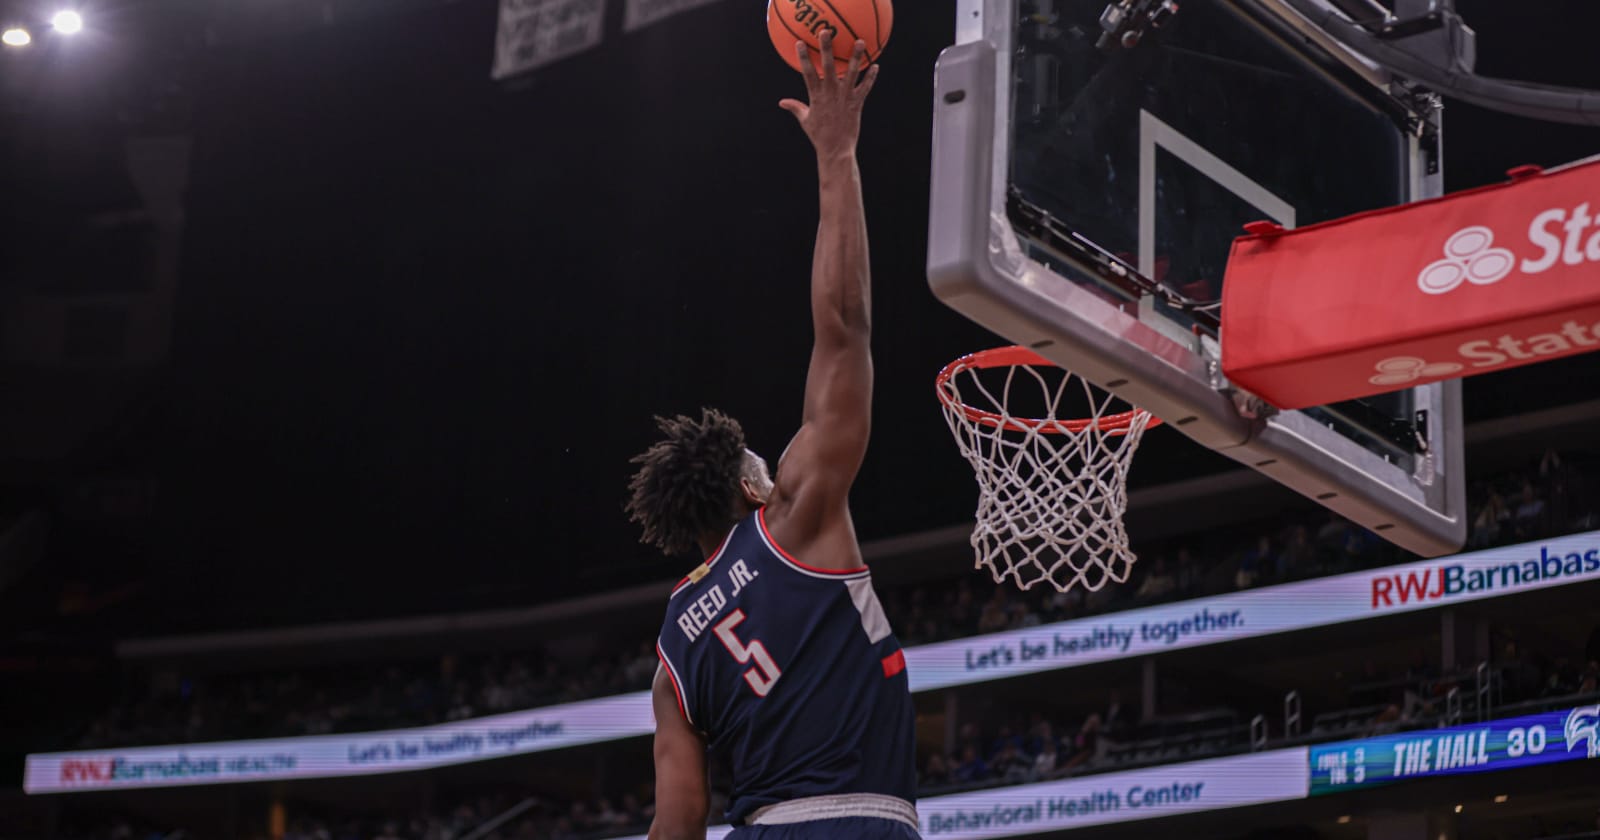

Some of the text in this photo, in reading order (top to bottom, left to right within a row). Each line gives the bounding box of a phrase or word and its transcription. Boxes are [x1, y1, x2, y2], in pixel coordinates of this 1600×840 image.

[677, 558, 759, 643] REED JR.
[713, 607, 782, 698] 5
[965, 608, 1245, 671] Let's be healthy together.
[396, 738, 418, 760] be
[423, 730, 482, 754] healthy
[1354, 748, 1365, 765] 3
[1394, 725, 1546, 777] THE HALL 30
[1354, 766, 1365, 784] 3
[928, 781, 1204, 835] Behavioral Health Center
